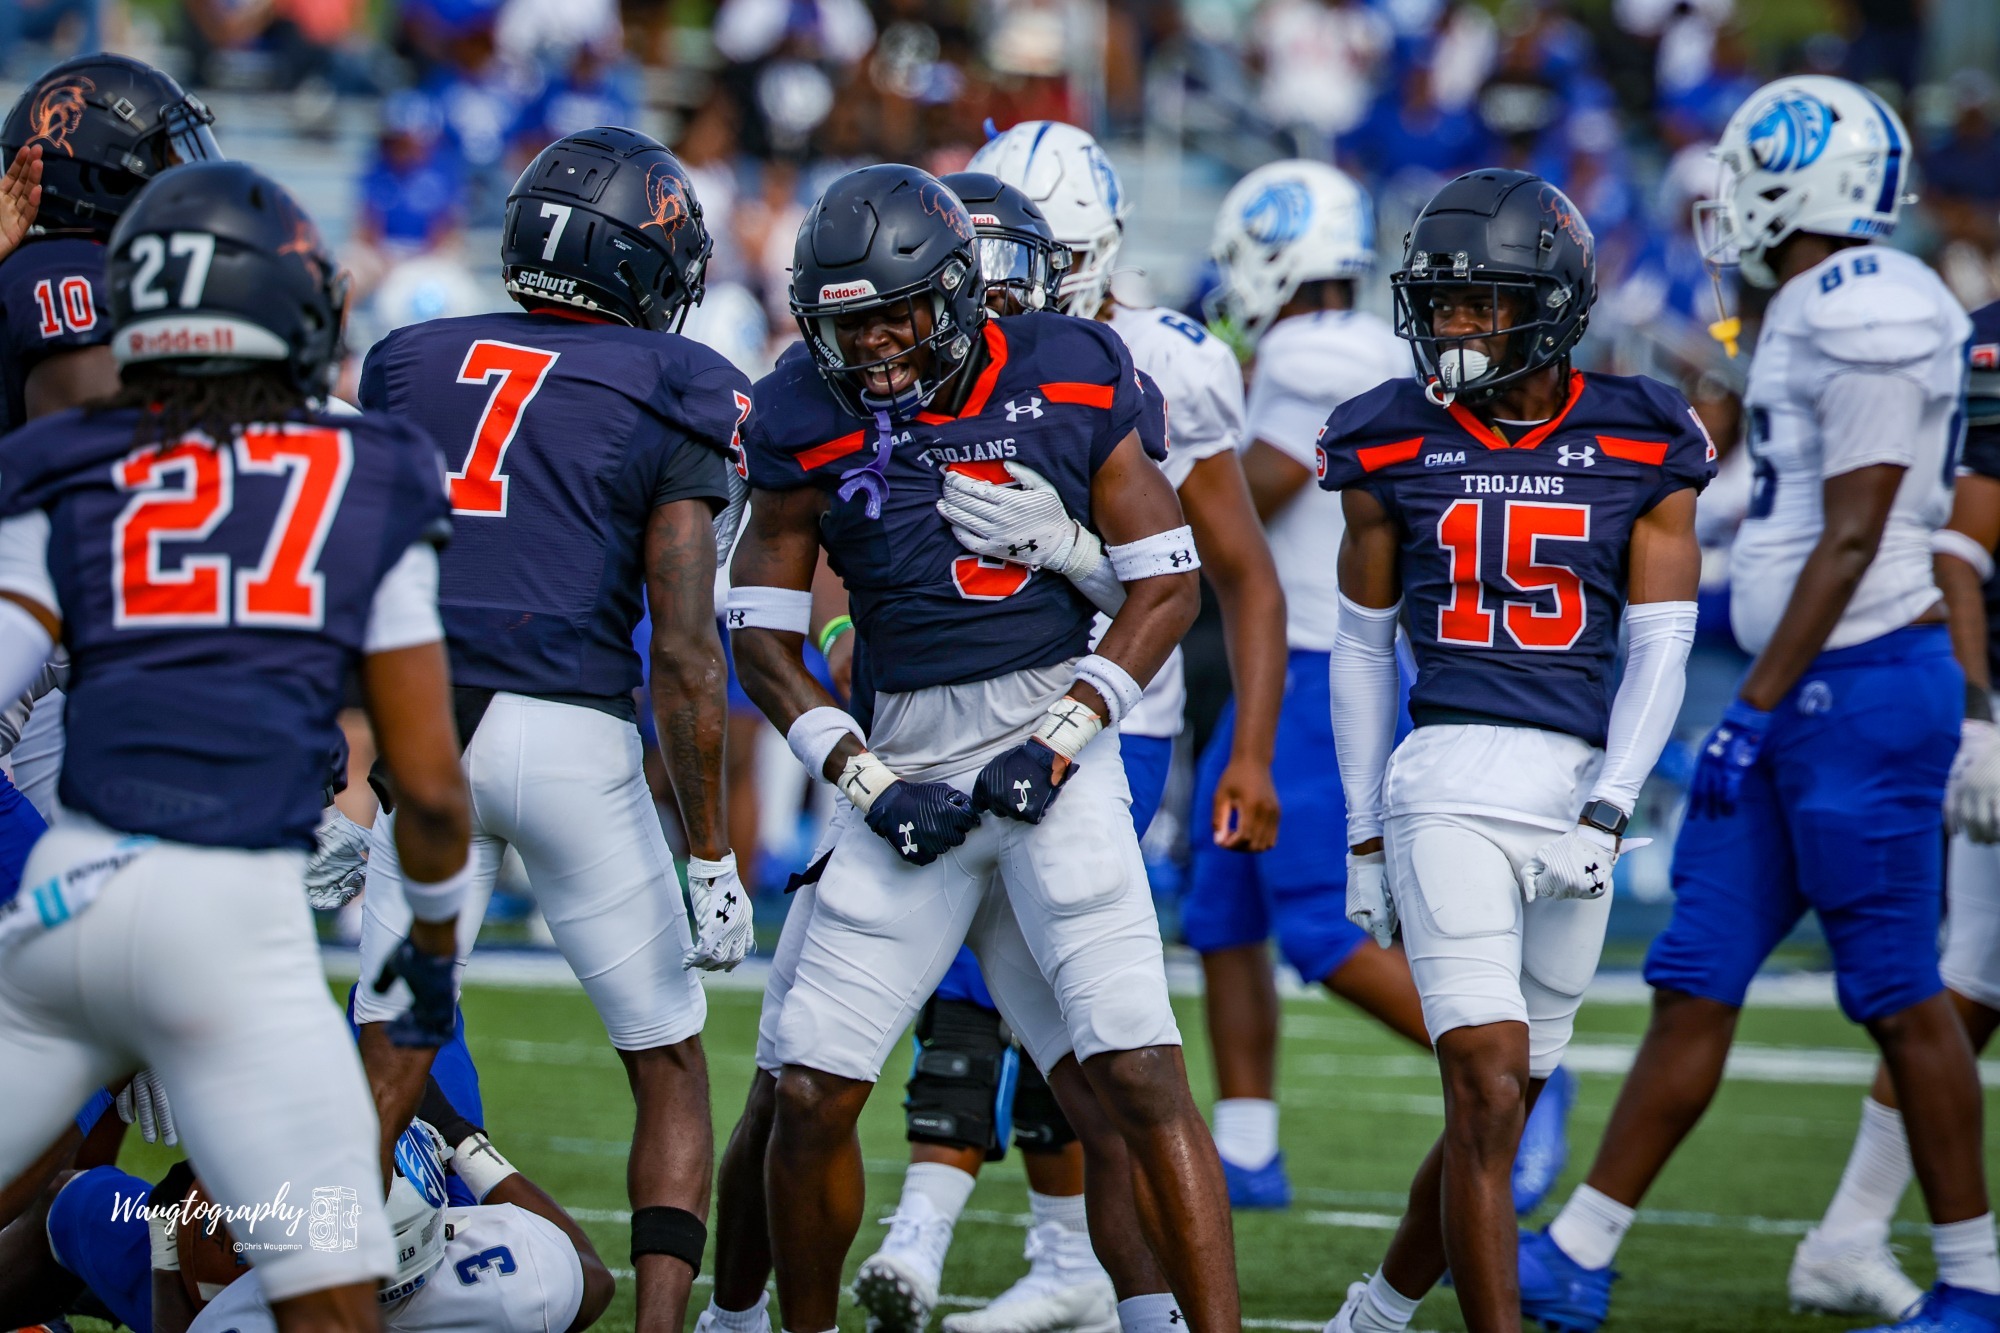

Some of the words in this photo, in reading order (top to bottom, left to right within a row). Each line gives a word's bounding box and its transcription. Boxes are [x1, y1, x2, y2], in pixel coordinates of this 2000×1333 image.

[539, 203, 573, 261] 7
[129, 233, 216, 309] 27
[518, 270, 578, 295] schutt
[34, 275, 98, 339] 10
[129, 327, 234, 353] Riddell
[445, 339, 561, 518] 7
[917, 437, 1018, 468] TROJANS
[1424, 451, 1466, 467] CIAA
[1460, 475, 1565, 495] TROJANS
[111, 422, 355, 629] 27
[1437, 498, 1591, 651] 15
[453, 1243, 519, 1287] 3
